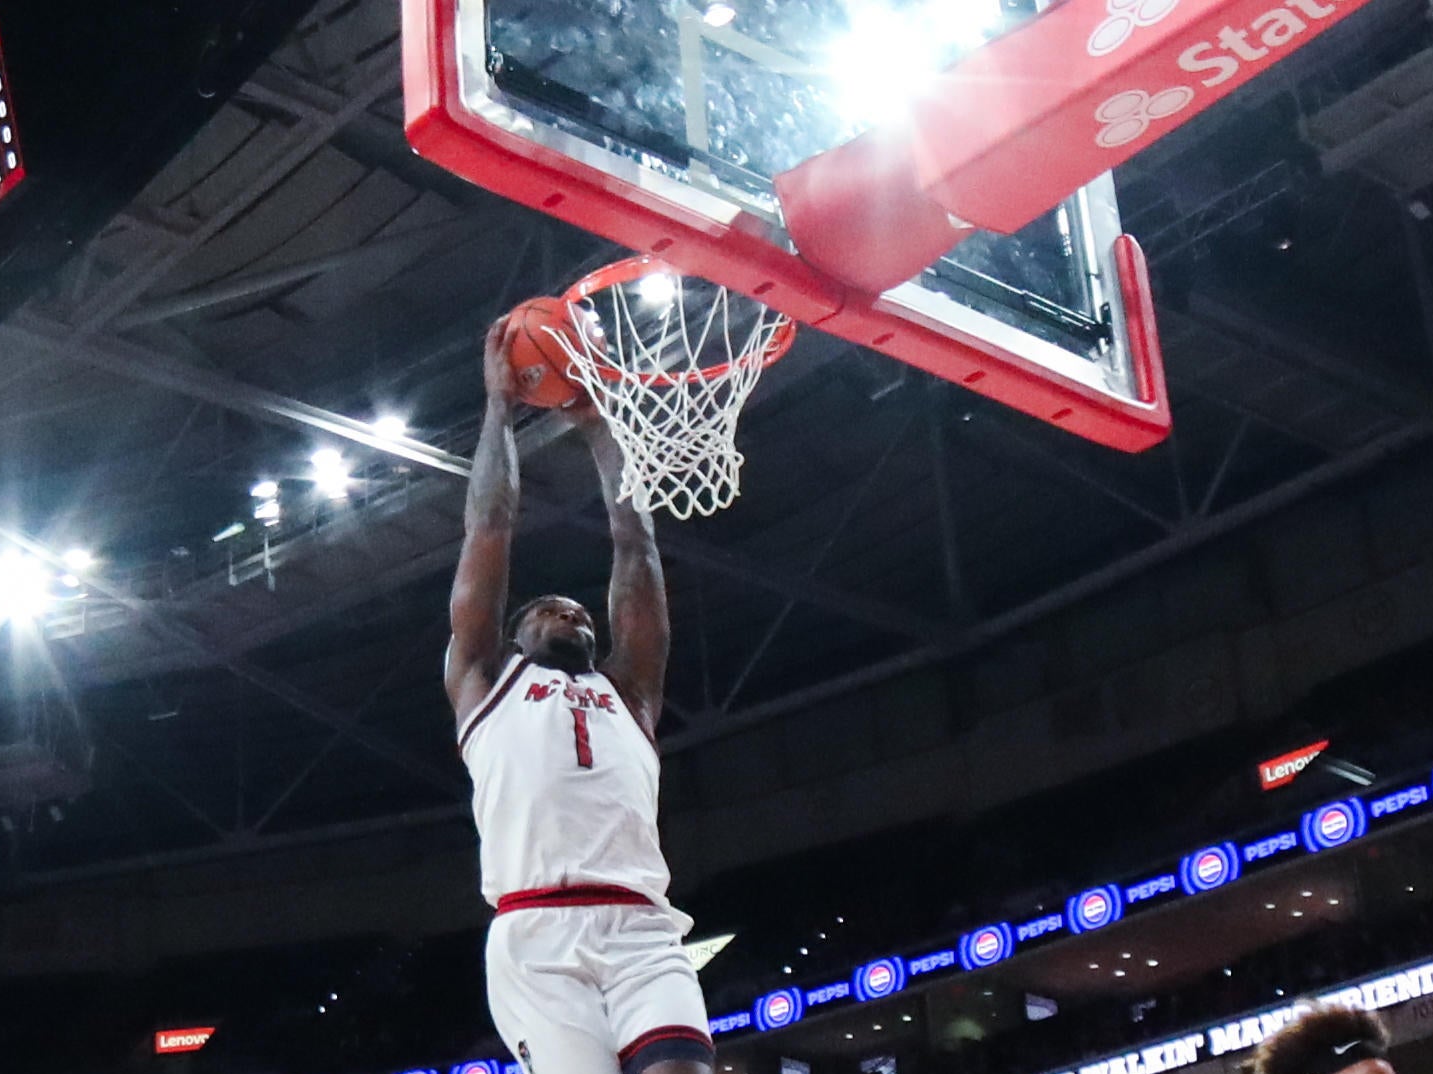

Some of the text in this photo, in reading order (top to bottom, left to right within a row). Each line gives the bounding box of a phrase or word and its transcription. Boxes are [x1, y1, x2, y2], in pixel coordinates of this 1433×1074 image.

[1177, 0, 1337, 87] Stat
[3, 126, 12, 143] 0
[7, 152, 17, 169] 0
[569, 707, 593, 769] 1
[1264, 750, 1320, 782] Lenov
[1370, 786, 1428, 817] PEPSI
[1242, 832, 1297, 862] PEPSI
[1125, 875, 1176, 903] PEPSI
[1017, 914, 1063, 941] PEPSI
[909, 951, 955, 976] PEPSI
[806, 983, 850, 1006] PEPSI
[710, 1012, 750, 1034] PEPSI
